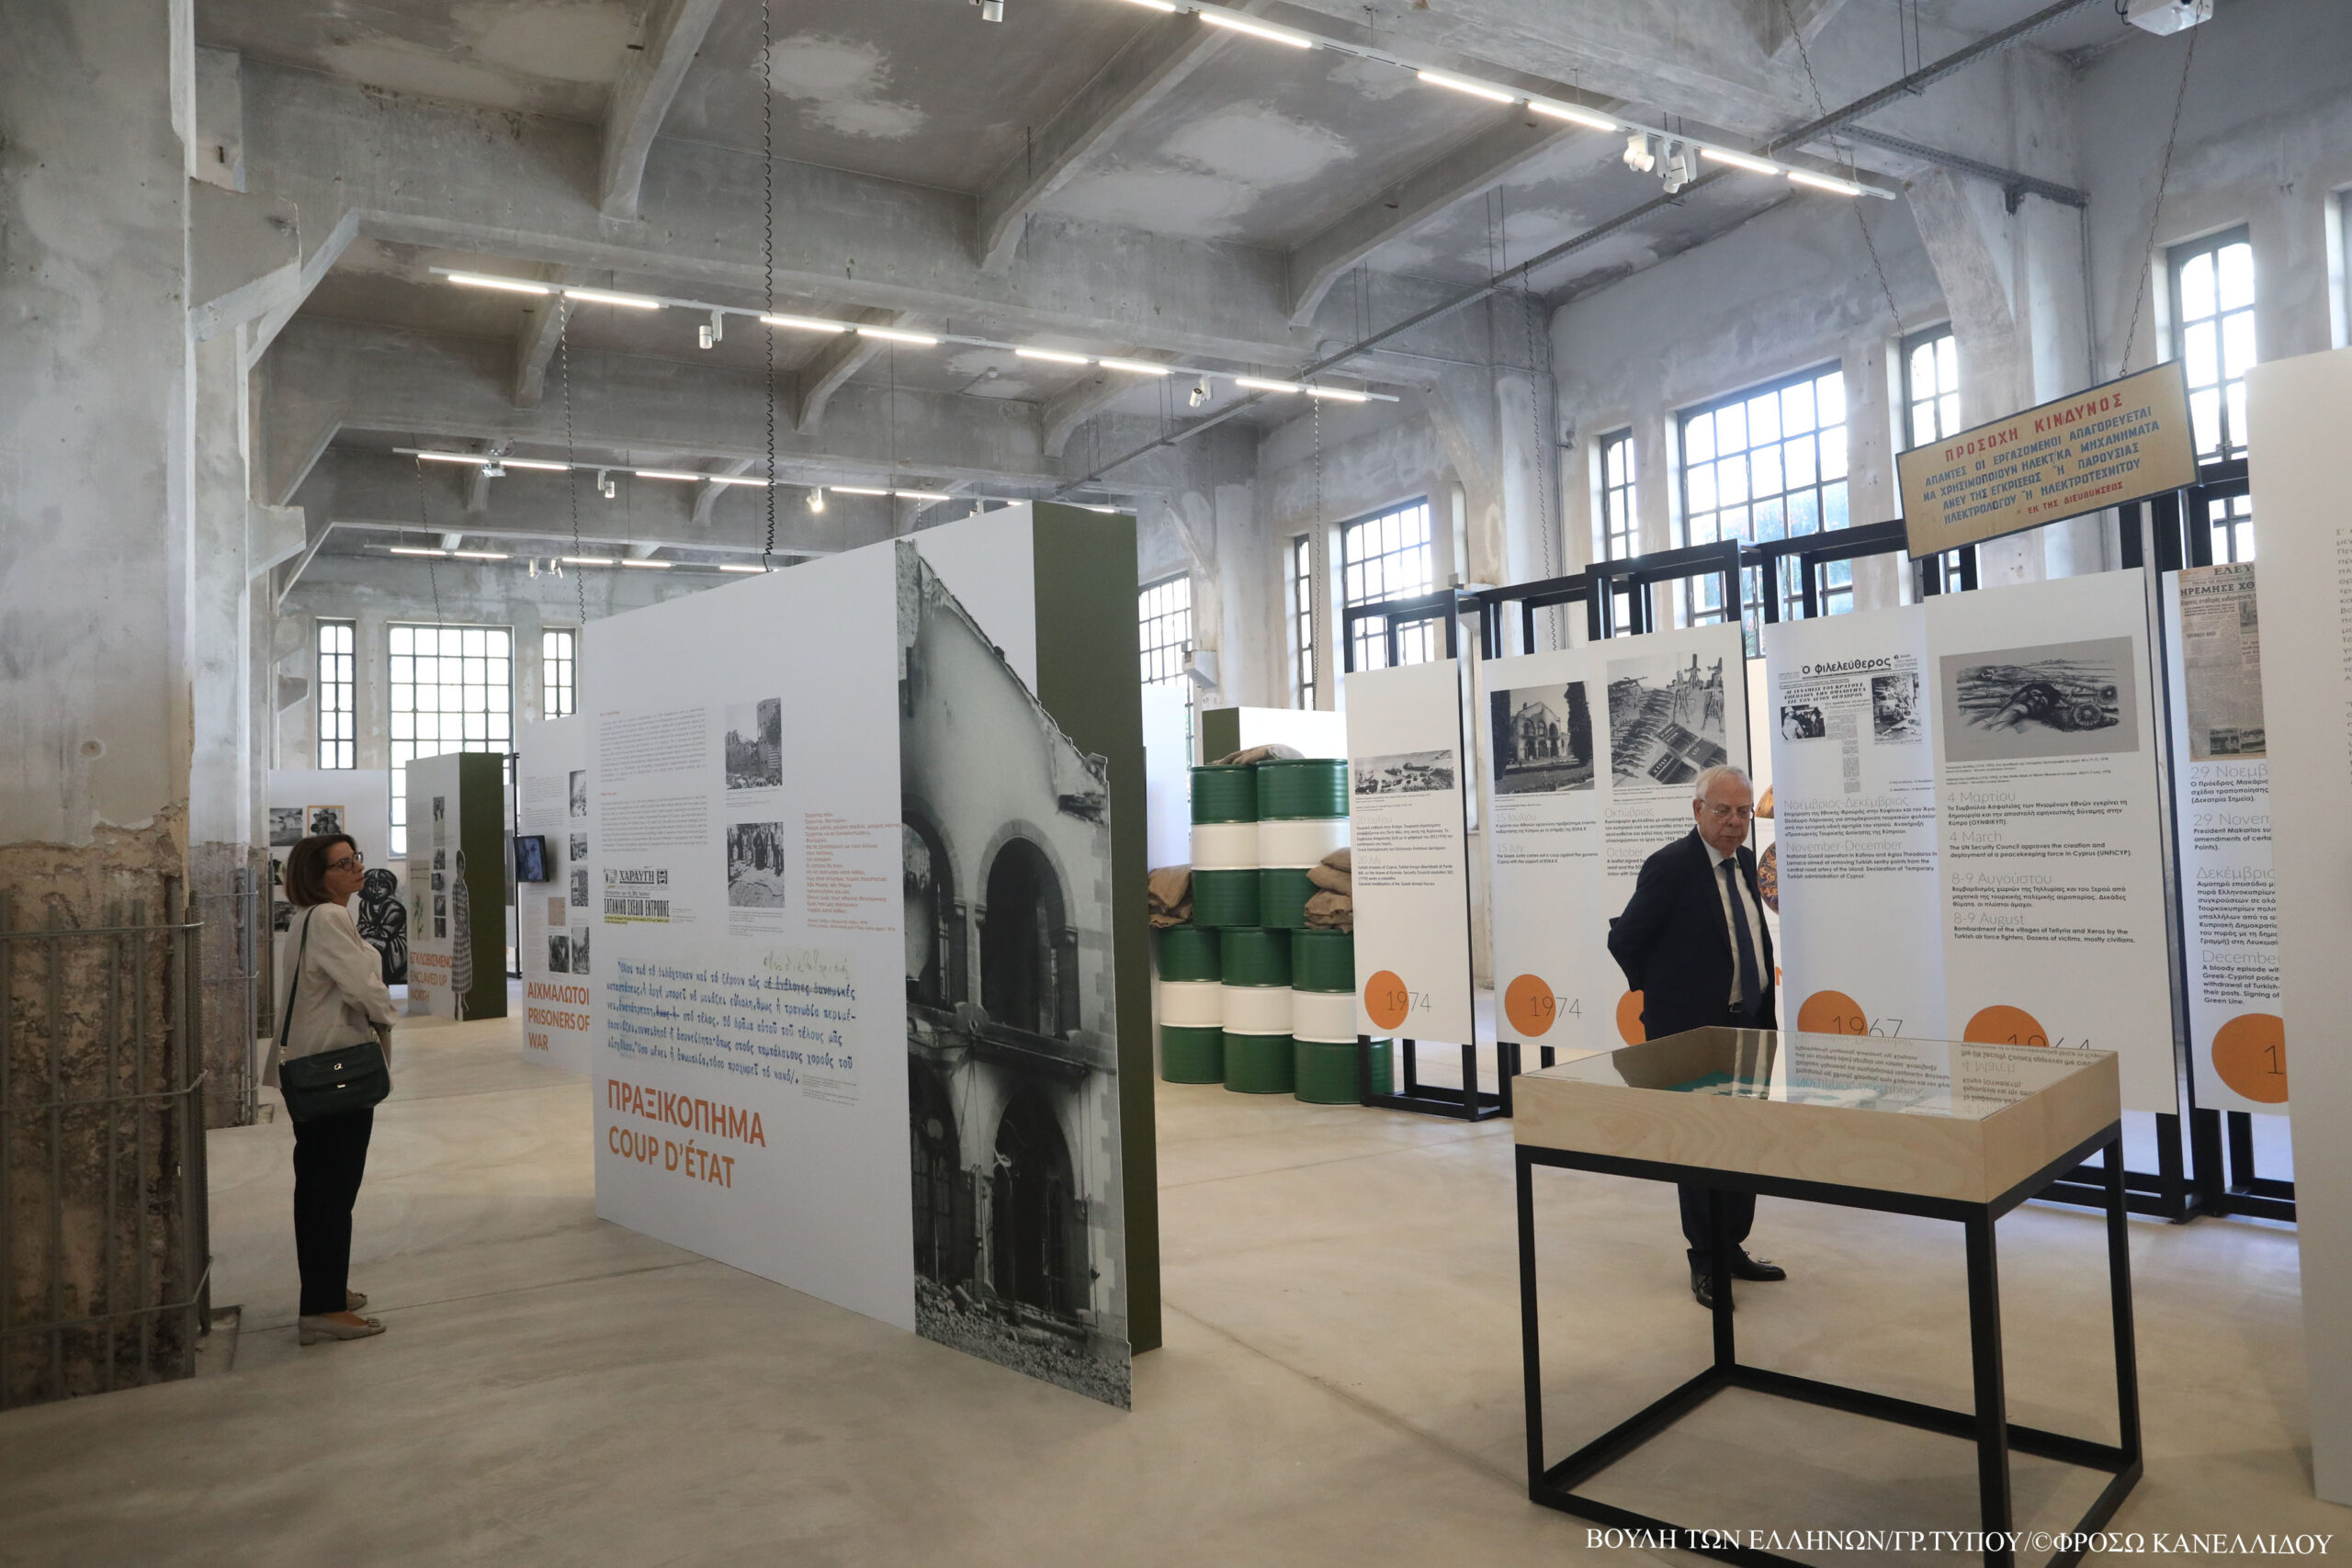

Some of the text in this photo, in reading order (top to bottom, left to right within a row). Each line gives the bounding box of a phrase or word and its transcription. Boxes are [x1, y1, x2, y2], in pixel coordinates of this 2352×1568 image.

[1945, 393, 2123, 462] ΠΡΟΣΟΧΗ ΚΙΝΔΥΝΟΣ
[1925, 406, 2152, 487] ΑΠΑΝΤΕΣ ΟΙ ΕΡΓΑΖΟΜΕΝΟΙ ΑΠΑΓΟΡΕΥΕΤΑΙ
[1923, 421, 2160, 502] ΝΑ ΧΡΗΣΙΜΟΠΟΙΟΥΝ ΗΛΕΚΤ/ΚΑ ΜΗΧΑΝΗΜΑΤΑ
[1942, 496, 1966, 511] ΑΝΕΥ
[1971, 488, 1988, 502] ΤΗΣ
[1991, 472, 2041, 496] ΕΓΚΡΙΣΕΩΣ
[2078, 442, 2140, 469] ΠΑΡΟΥΣΙΑΣ
[1944, 493, 2017, 525] ΗΛΕΚΤΡΟΛΟΓΟΥ
[2041, 458, 2141, 495] ΗΛΕΚΤΡΟΤΕΧΝΙΤΟΥ
[2028, 481, 2123, 515] ΕΚ ΤΗΣ ΔΙΕΥΘΥΝΣΕΩΣ
[2180, 581, 2255, 596] ΗΡΕΜΗΣΕ ΧΘ
[2190, 766, 2210, 780] 29
[2199, 780, 2234, 788] Πρόεδρος
[1948, 791, 2016, 805] 4 Μαρτίου
[2193, 813, 2212, 826] 29
[1950, 830, 2002, 842] 4 March
[2000, 851, 2046, 859] peacekeeping
[2073, 850, 2096, 858] Cyprus
[619, 871, 654, 881] ΧΑΡΑΥΓΗ
[1951, 873, 1973, 885] 8-9
[1953, 912, 2026, 927] 8-9 August
[2016, 926, 2040, 934] villages
[2202, 972, 2255, 981] Greek-Cypriot
[2209, 964, 2235, 973] bloody
[411, 970, 447, 987] ENCLAVED UP
[411, 988, 429, 1001] NORTH
[527, 982, 589, 1005] ΑΙΧΜΑΛΩΤΟΙ
[1386, 990, 1432, 1013] 1974
[2243, 990, 2270, 999] Signing
[1530, 995, 1582, 1020] 1974
[528, 1007, 590, 1032] PRISONERS OF
[1833, 1016, 1903, 1037] 1967
[528, 1032, 548, 1051] WAR
[607, 1079, 766, 1147] ΠΡΑΞΙΚΟΠΗΜΑ
[609, 1126, 659, 1166] COUP
